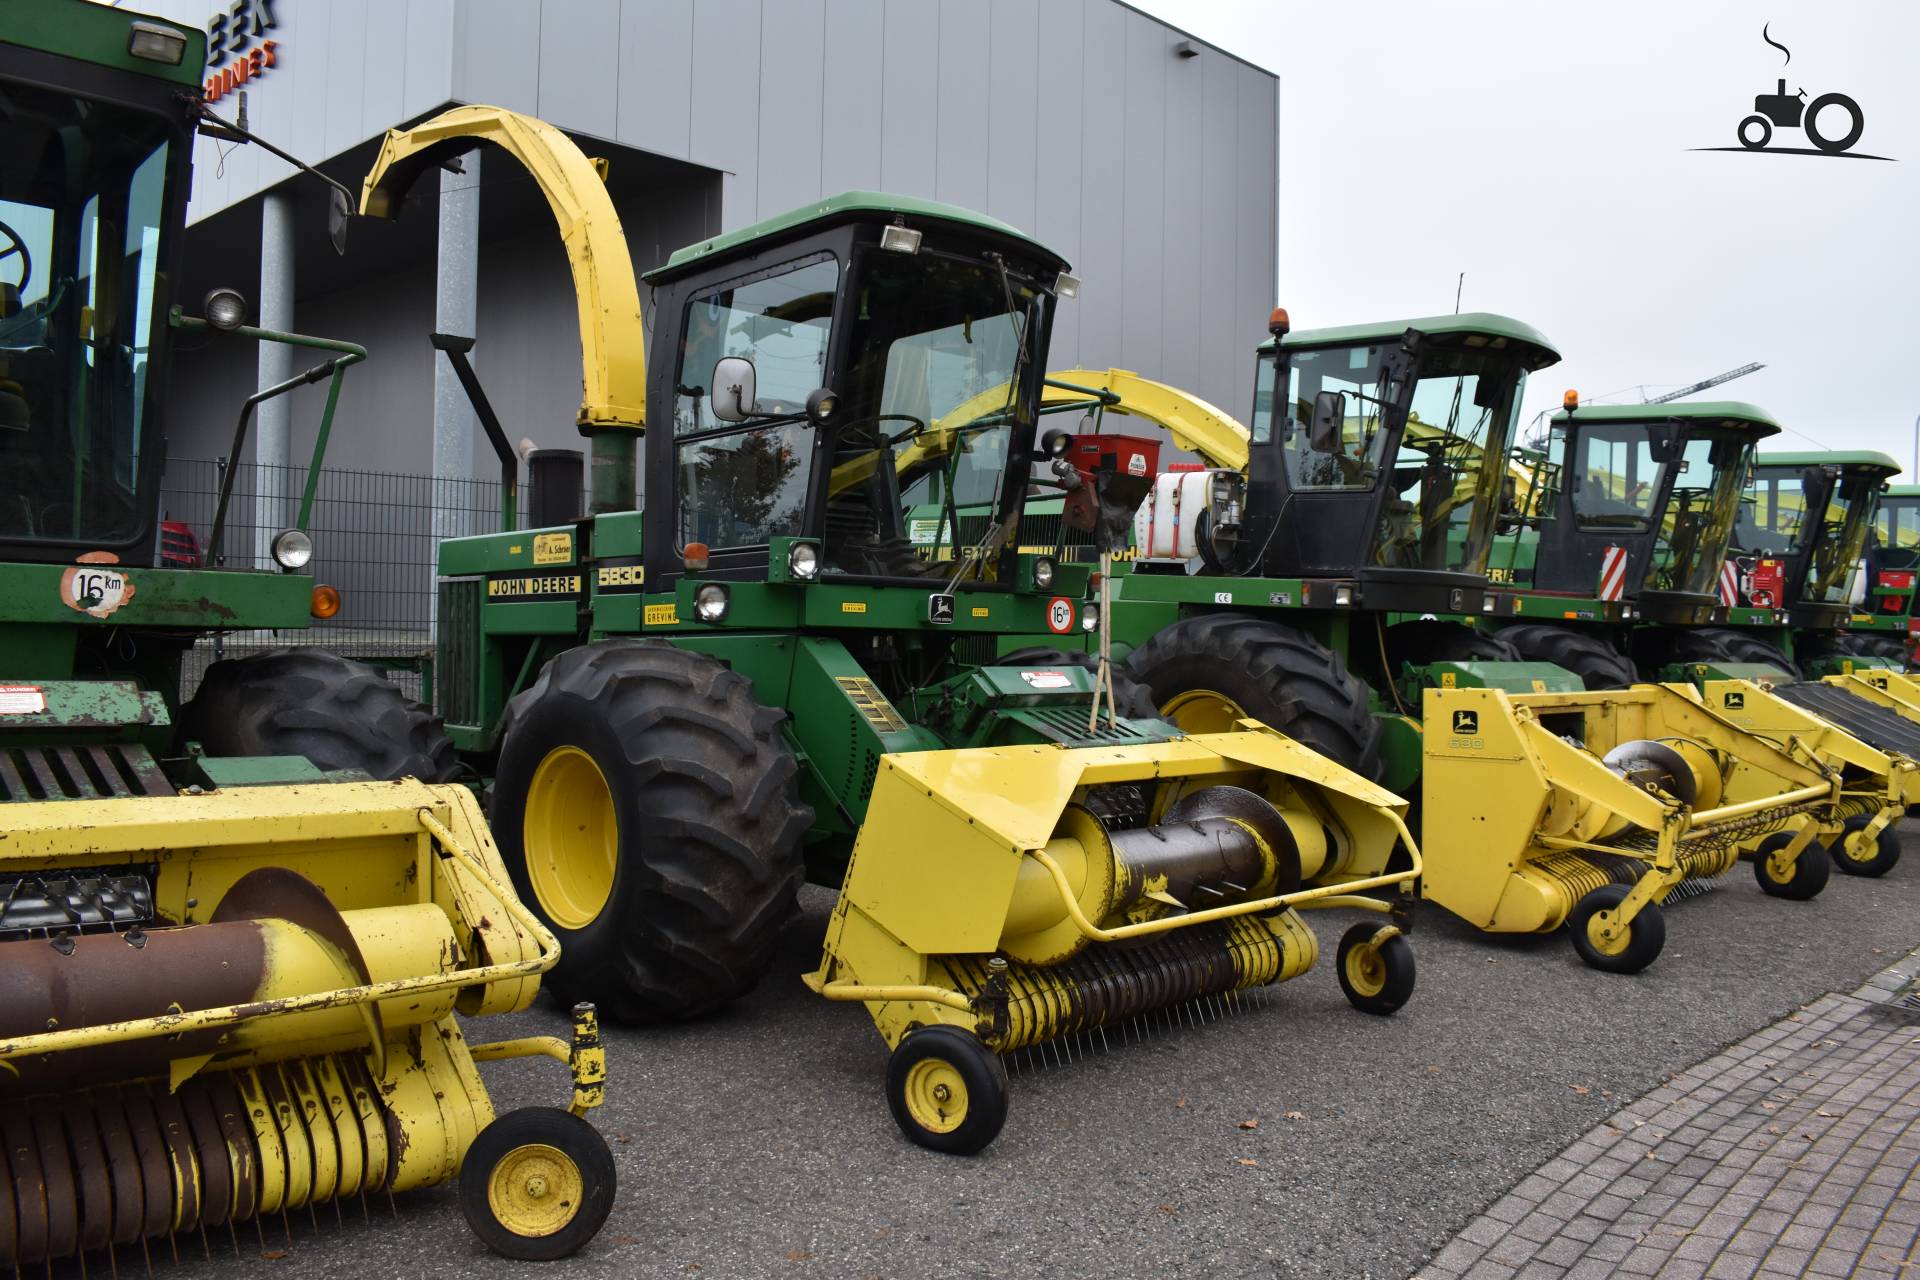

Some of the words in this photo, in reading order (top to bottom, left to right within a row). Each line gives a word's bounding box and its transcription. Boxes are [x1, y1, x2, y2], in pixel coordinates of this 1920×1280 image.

[599, 566, 645, 585] 5830
[79, 574, 104, 600] 16
[105, 576, 120, 589] km
[494, 579, 526, 595] JOHN
[532, 577, 575, 594] DEERE
[1218, 593, 1230, 602] CE
[647, 612, 677, 622] GREVING
[1053, 606, 1063, 623] 16
